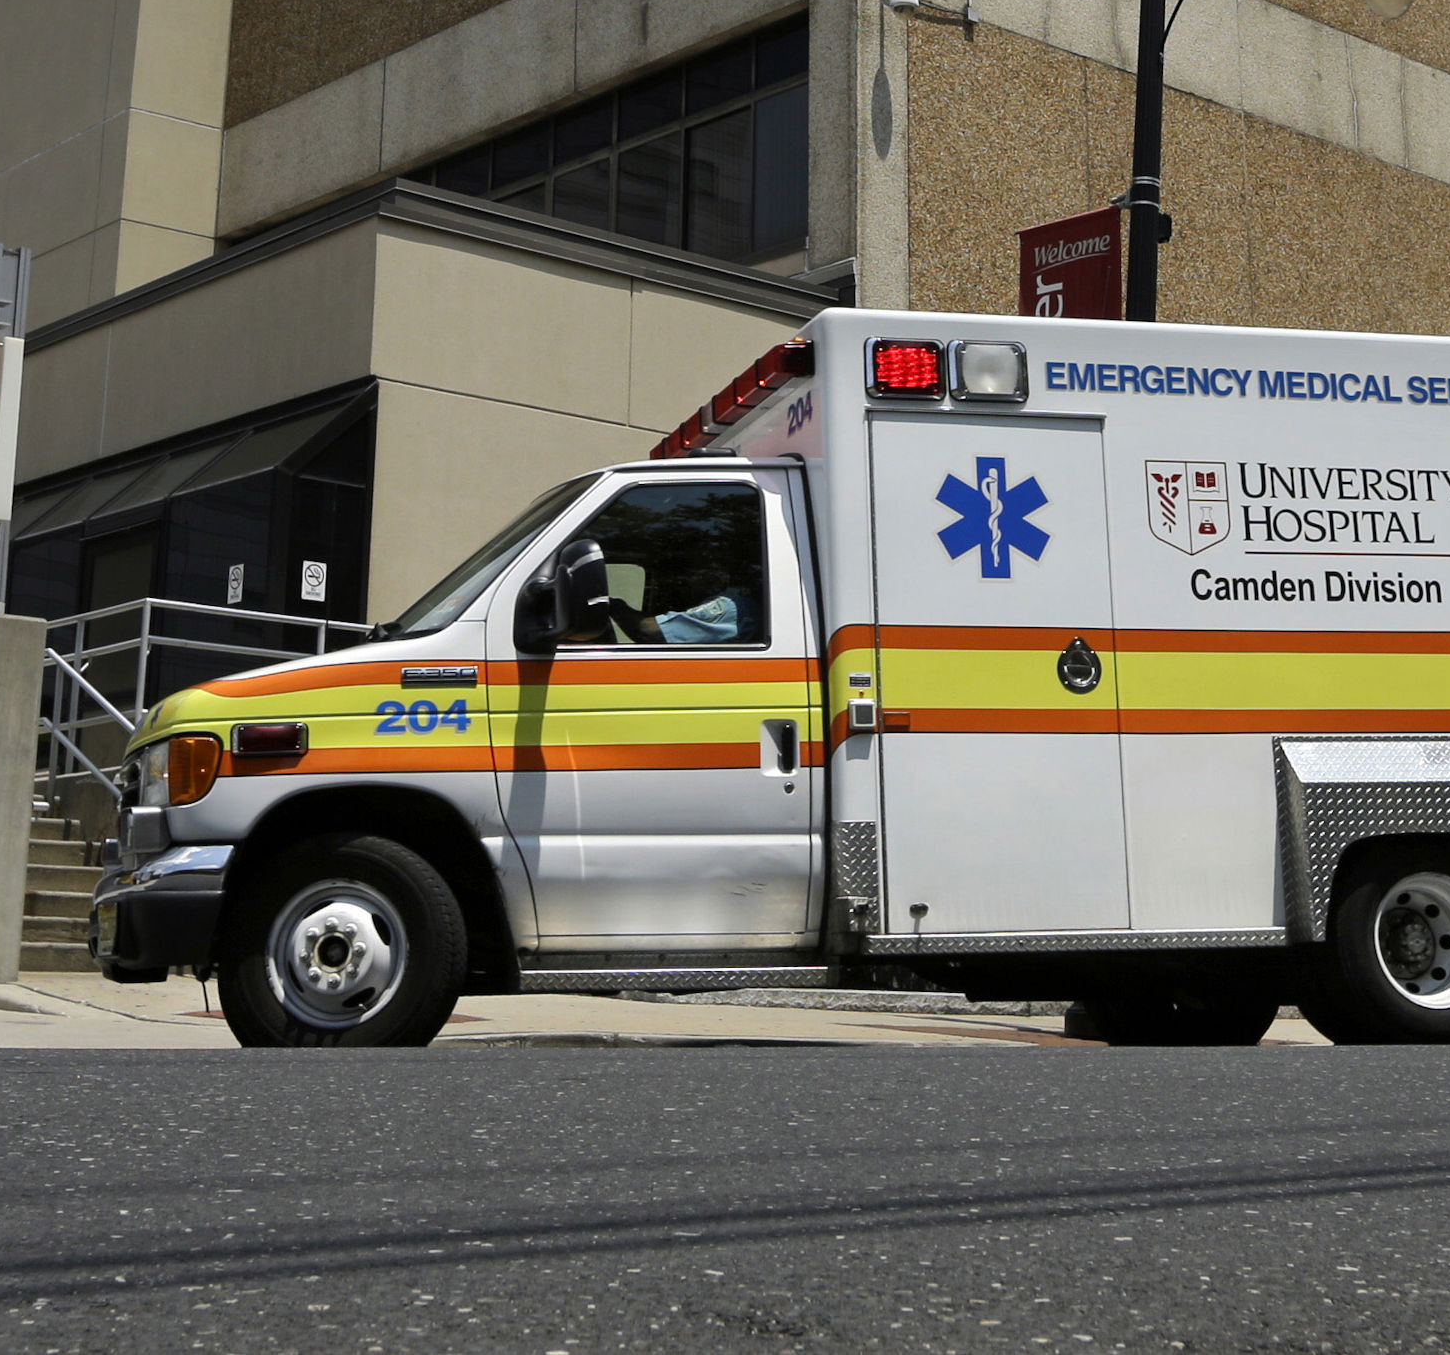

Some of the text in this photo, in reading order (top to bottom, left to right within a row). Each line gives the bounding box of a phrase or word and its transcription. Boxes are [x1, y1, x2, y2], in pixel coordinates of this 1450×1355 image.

[1034, 234, 1111, 268] Welcome
[1045, 361, 1253, 398] EMERGENCY
[1258, 370, 1403, 403] MEDICAL
[787, 390, 813, 437] 204
[1240, 505, 1437, 544] HOSPITAL
[1190, 568, 1443, 603] Camden Division
[374, 699, 472, 736] 204
